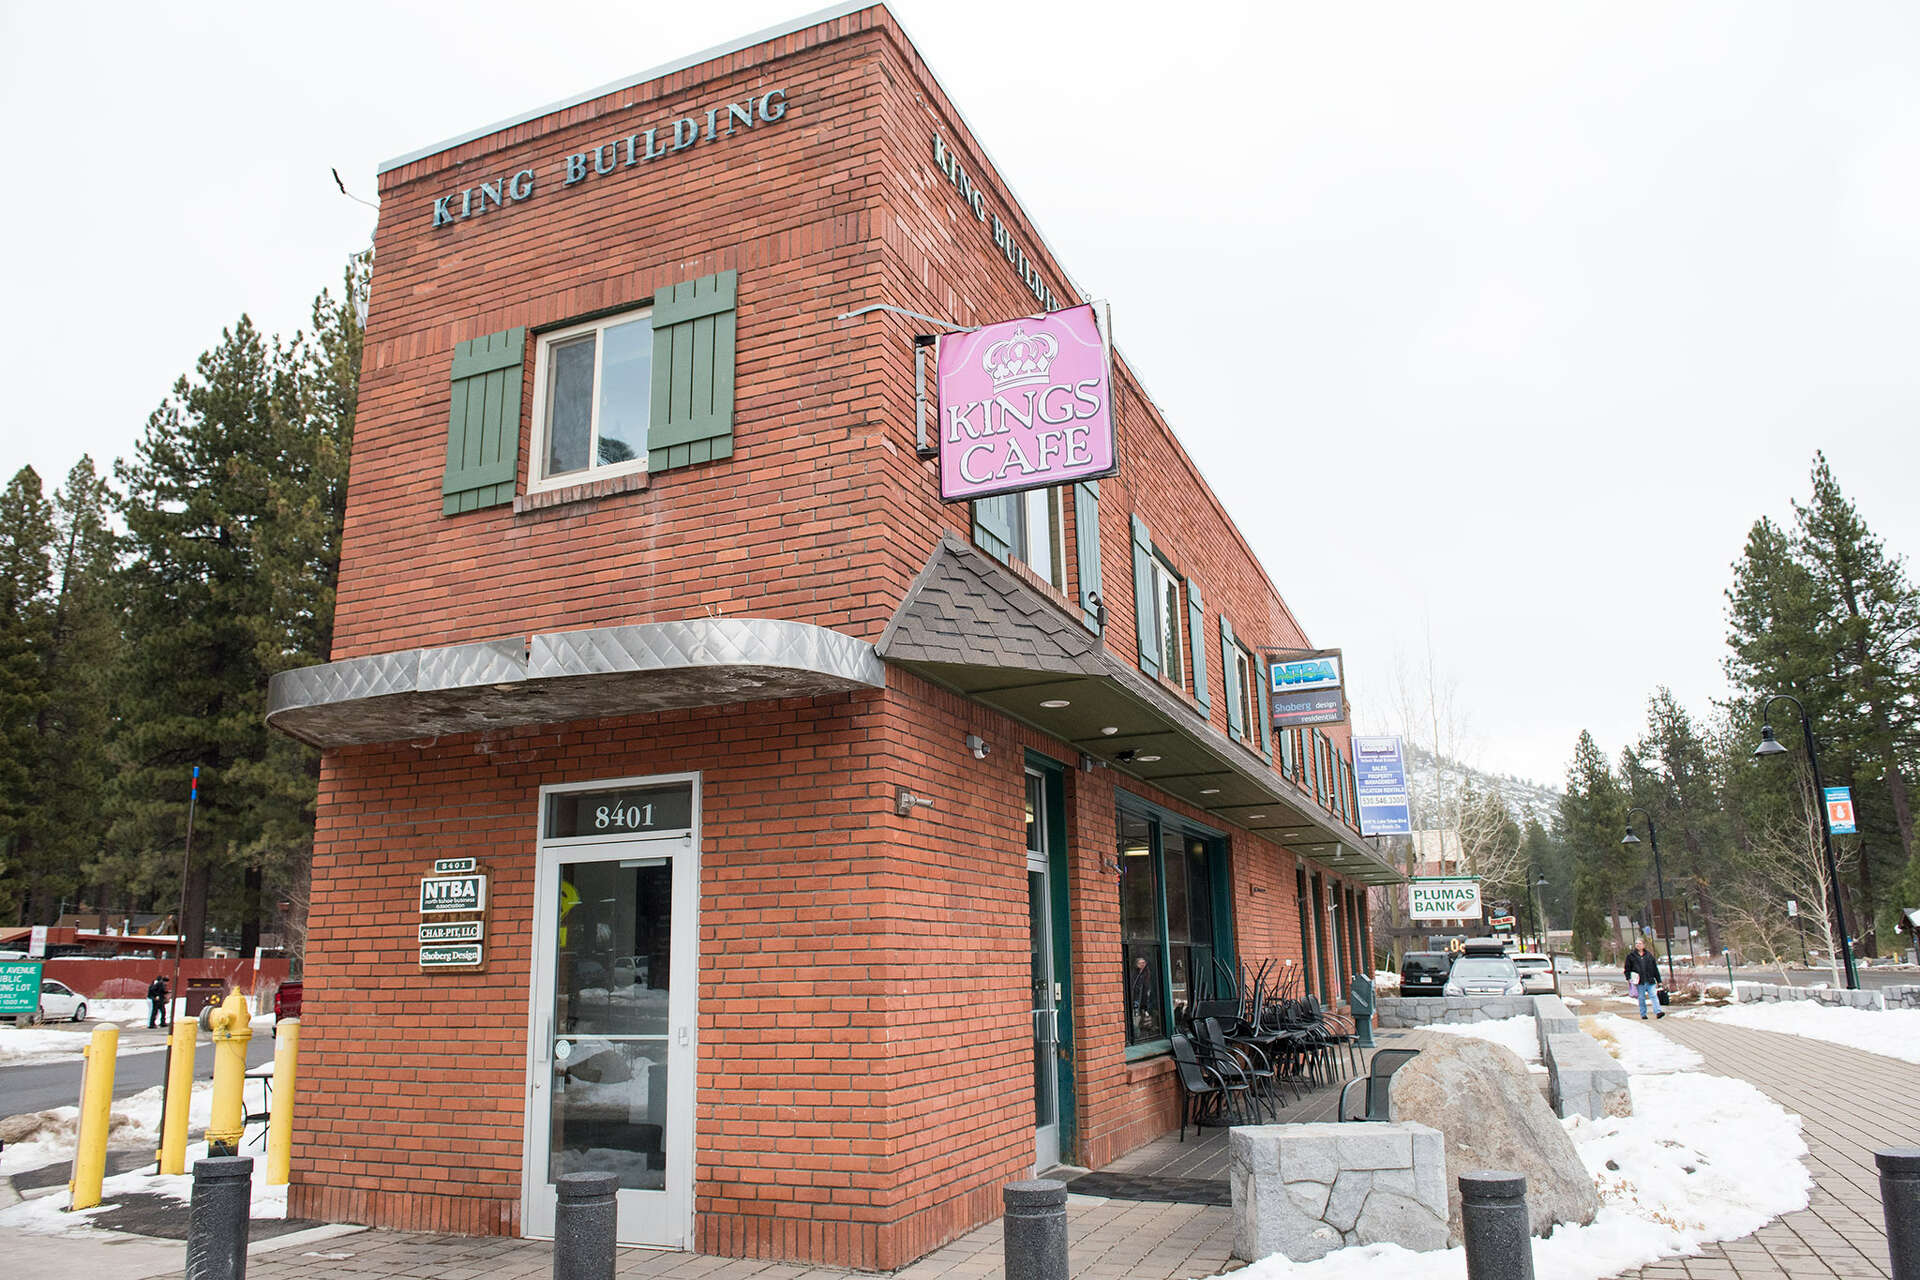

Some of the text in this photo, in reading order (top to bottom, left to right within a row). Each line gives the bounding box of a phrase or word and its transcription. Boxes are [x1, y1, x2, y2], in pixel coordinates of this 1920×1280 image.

[431, 88, 788, 228] KING BUILDING
[933, 133, 984, 222] KING
[947, 378, 1101, 443] KINGS
[960, 425, 1093, 484] CAFE
[1273, 661, 1337, 686] NTBA
[1274, 701, 1337, 713] Shoberg design
[1301, 713, 1338, 722] residential
[595, 800, 655, 830] 8401
[441, 862, 466, 870] 8401
[425, 880, 476, 899] NTBA
[1414, 889, 1475, 900] PLUMAS
[1415, 901, 1456, 912] BANK
[420, 926, 478, 938] CHAR-PIT, LLC
[421, 950, 478, 962] Shoberg Design
[6, 966, 37, 975] AVENUE
[15, 983, 32, 992] LOT
